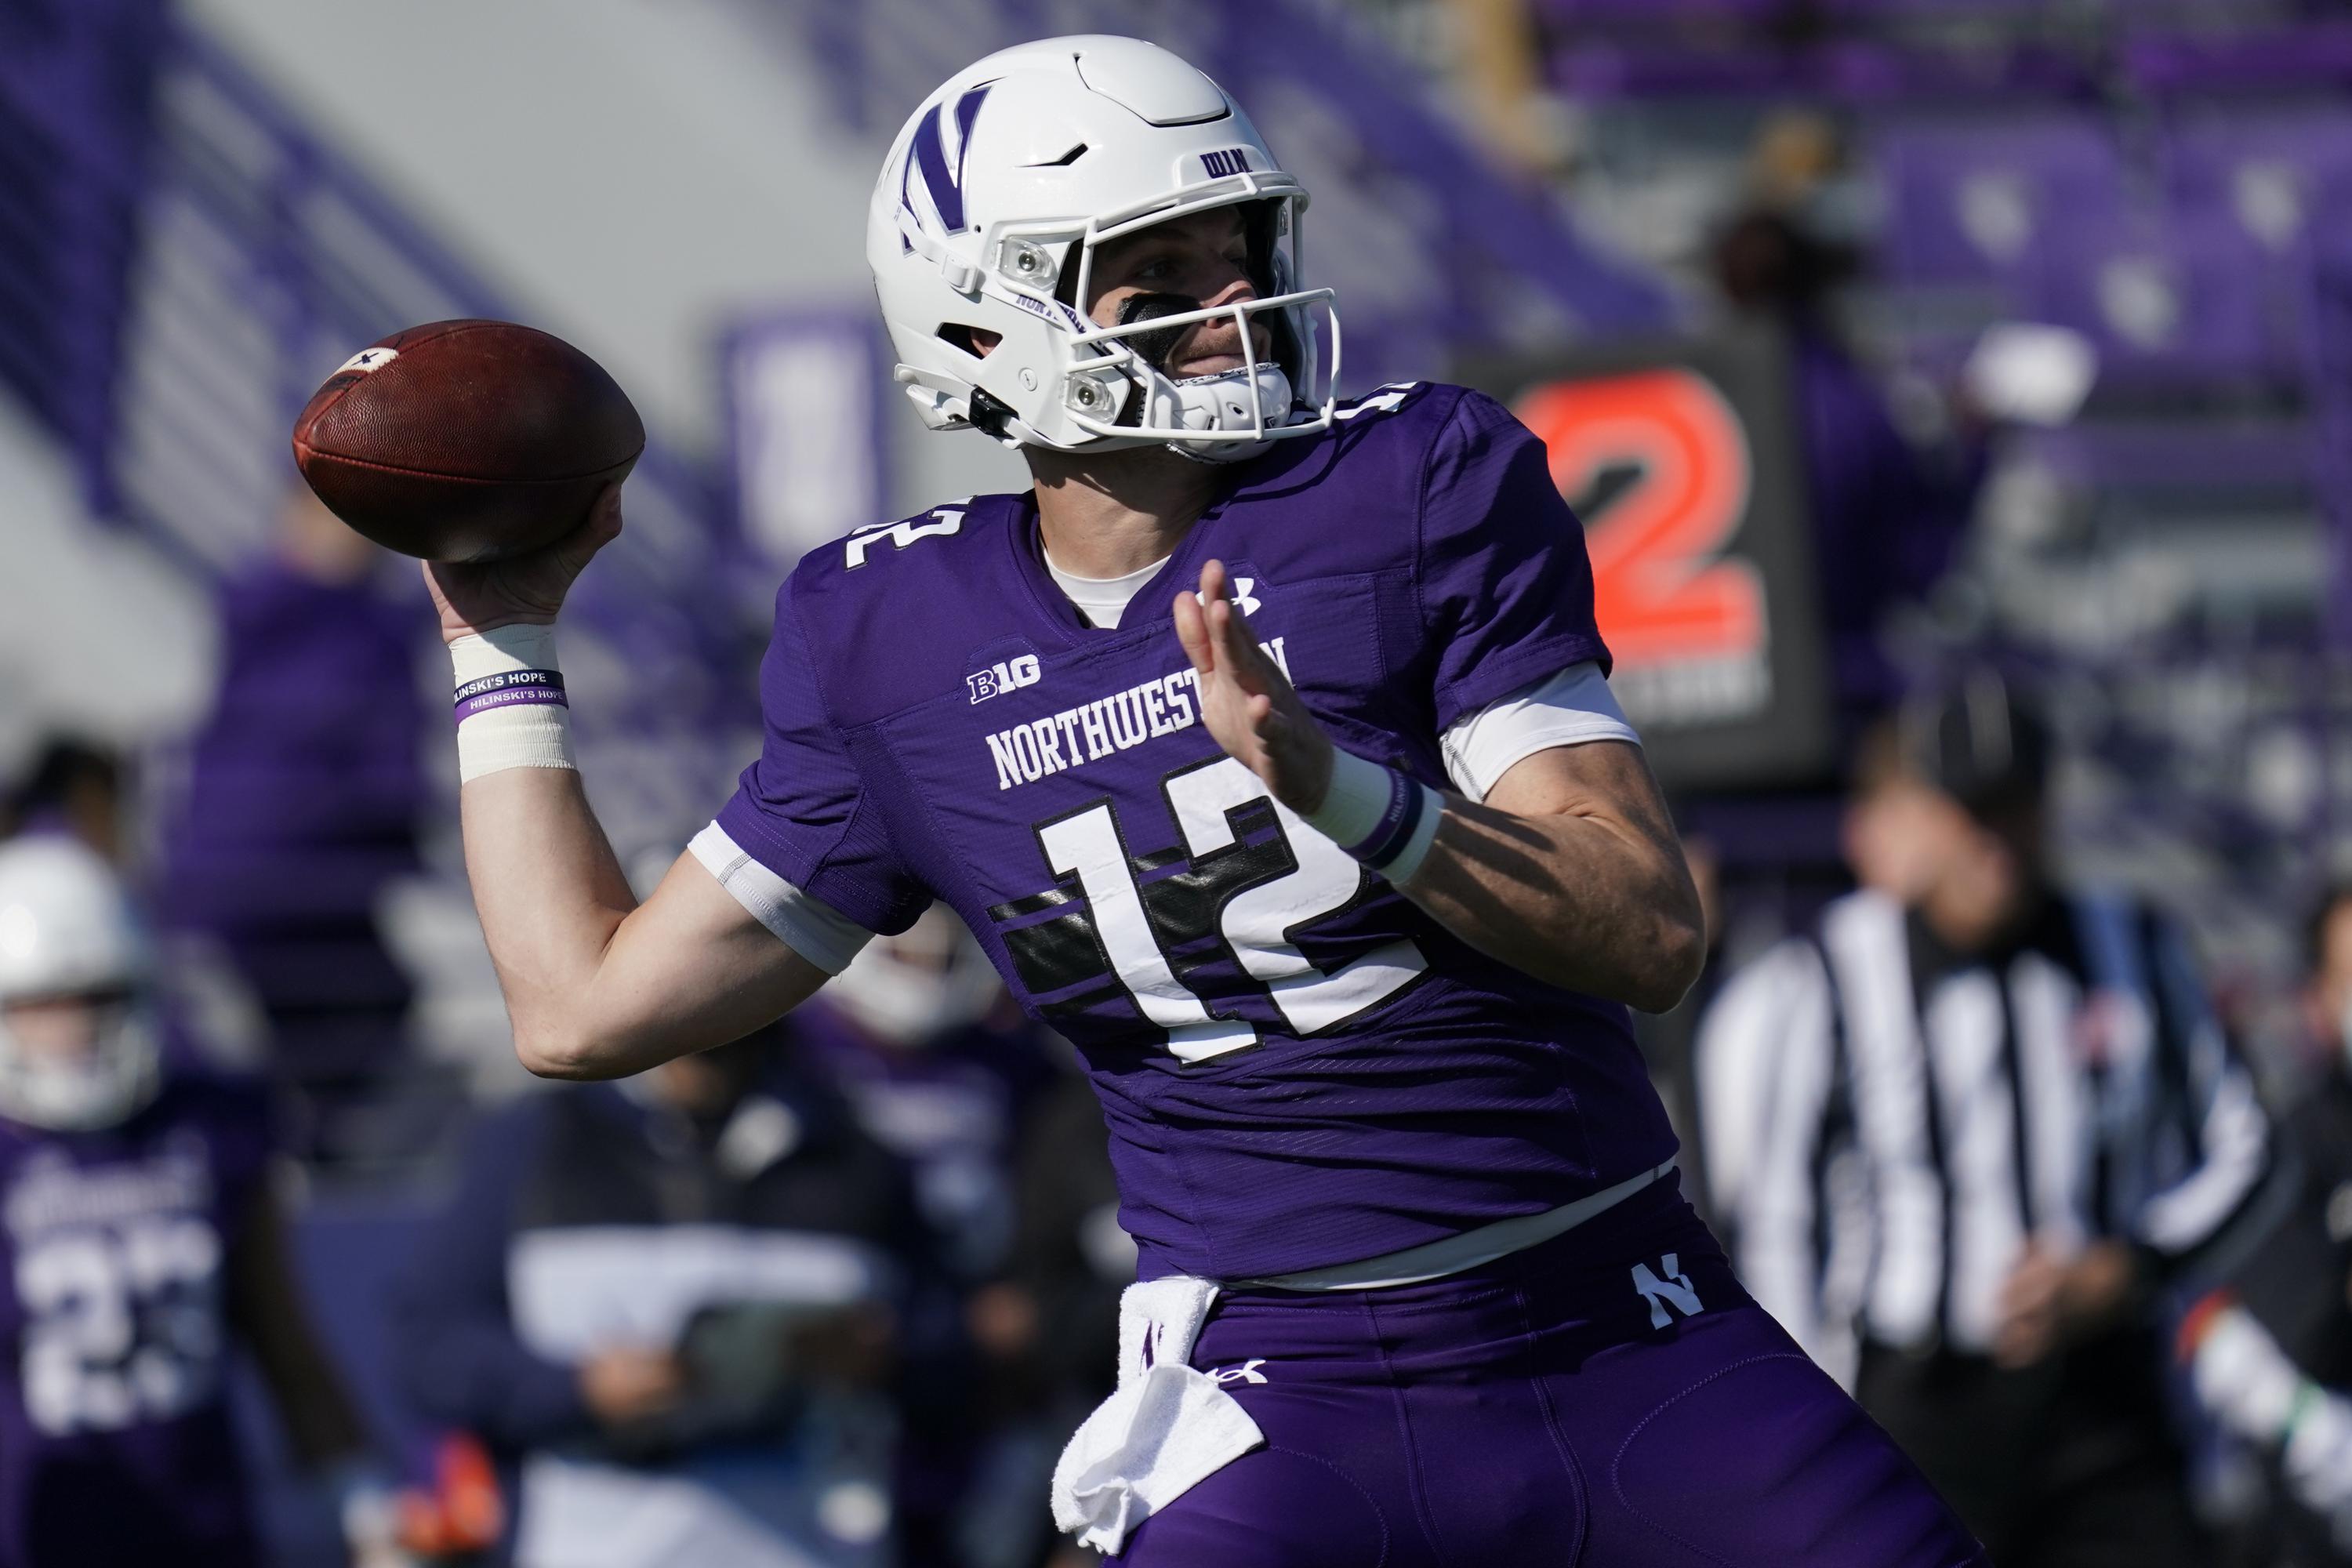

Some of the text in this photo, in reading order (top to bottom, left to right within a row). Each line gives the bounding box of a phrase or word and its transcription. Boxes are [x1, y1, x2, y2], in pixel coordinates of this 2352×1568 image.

[900, 85, 993, 258] N
[1199, 148, 1253, 180] WIN
[1509, 363, 1772, 670] 2
[455, 672, 546, 703] LINSKI'S HOPE
[470, 690, 564, 710] HILINSKI'S HOPE
[985, 637, 1295, 790] NORTHWESTN
[1033, 754, 1432, 1069] 12
[1630, 1252, 1705, 1330] N
